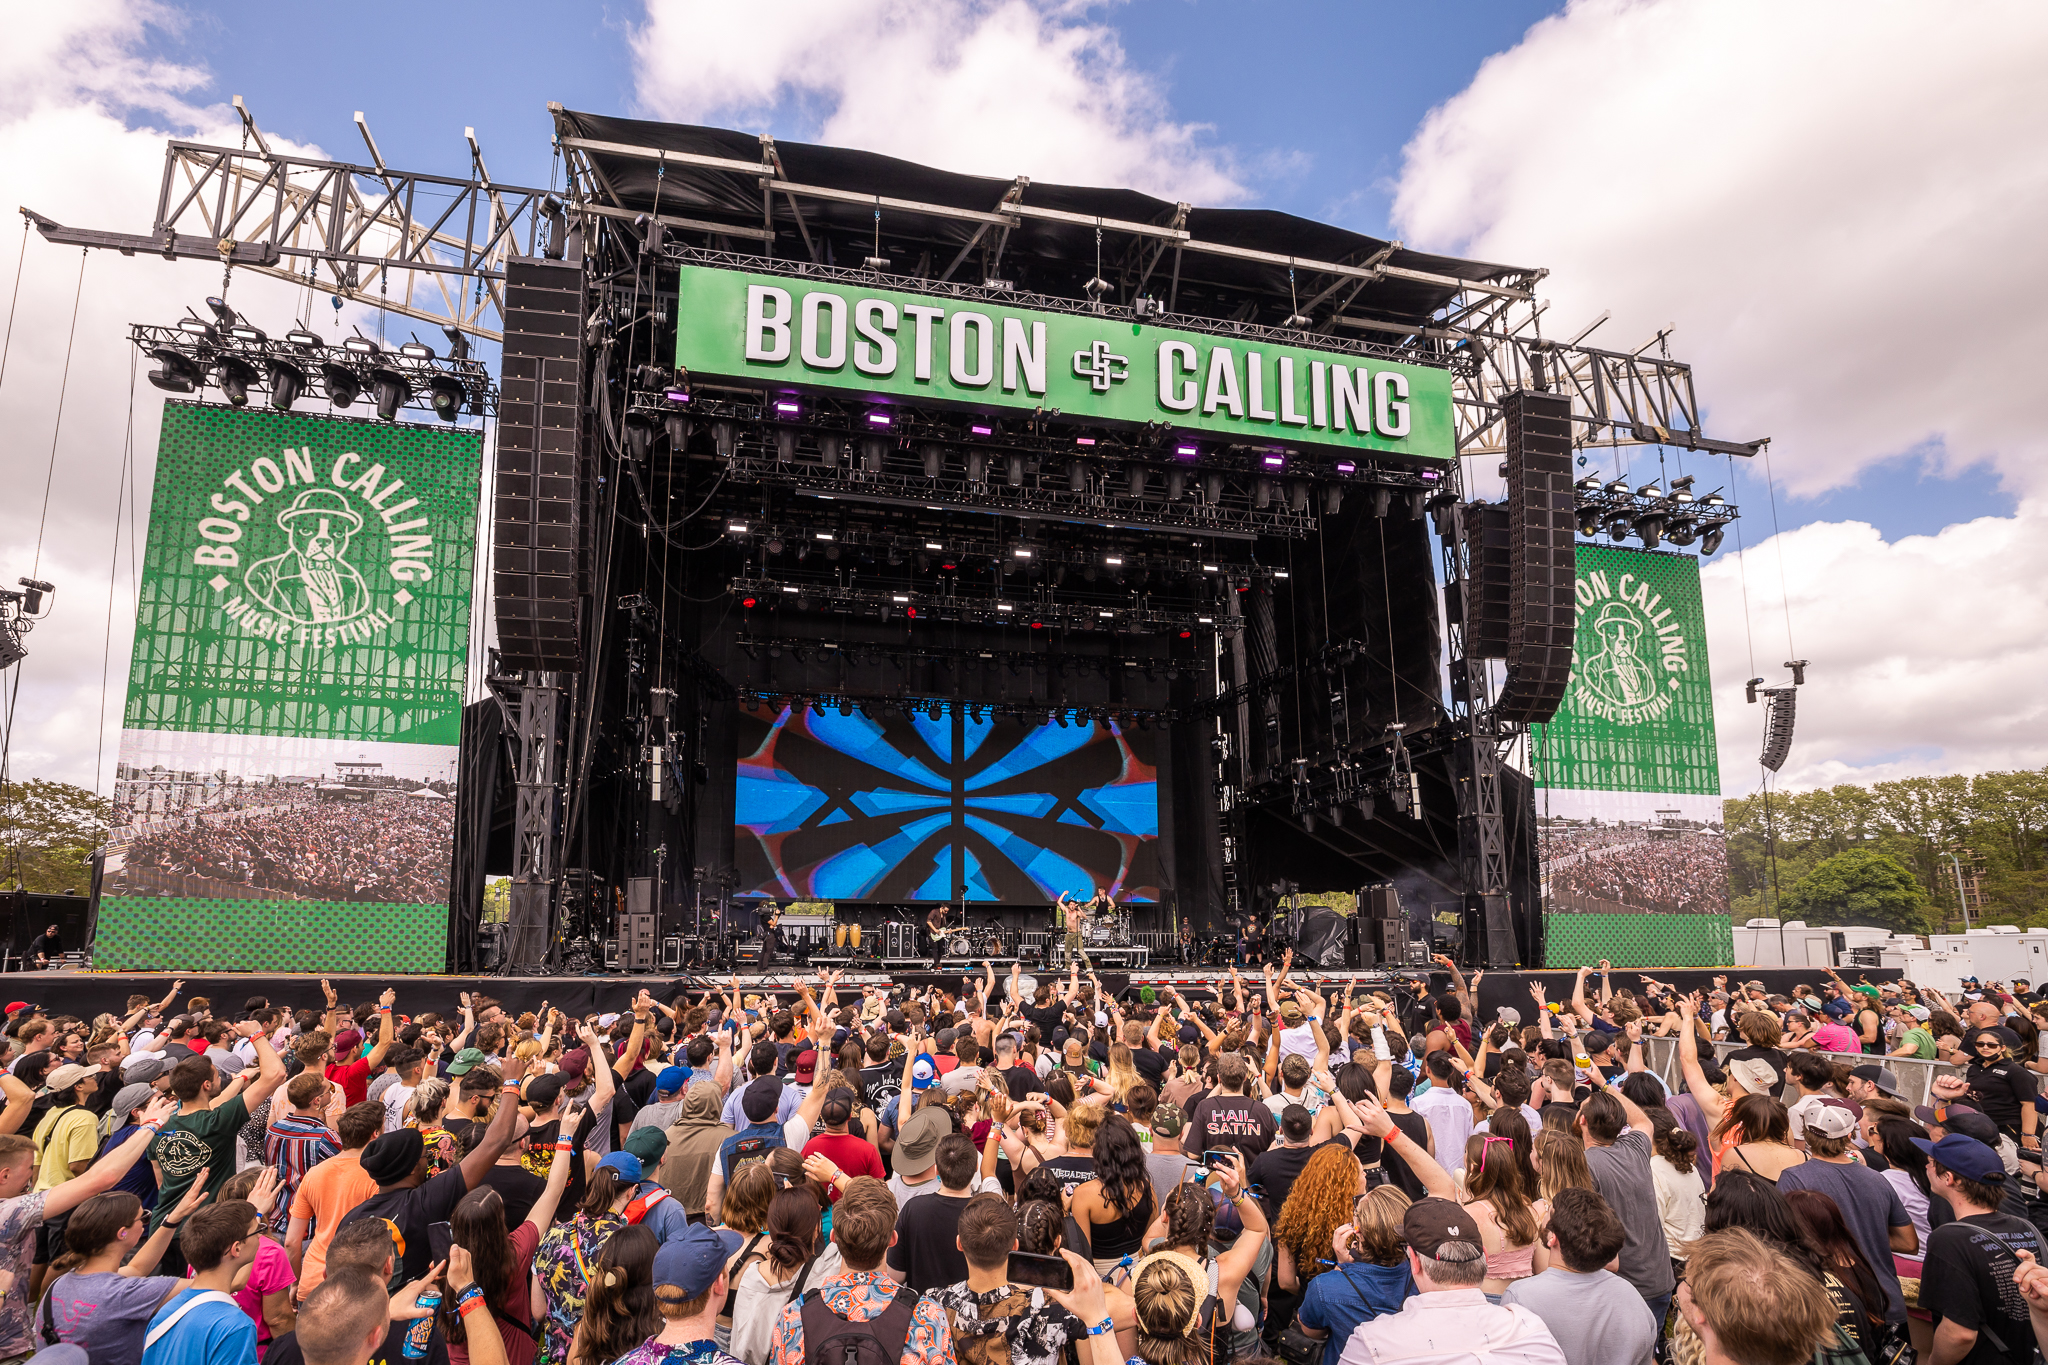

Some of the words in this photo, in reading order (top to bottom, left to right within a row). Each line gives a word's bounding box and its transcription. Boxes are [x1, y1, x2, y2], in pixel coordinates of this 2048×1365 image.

[744, 284, 1049, 394] BOSTON
[1158, 340, 1412, 437] CALLING
[193, 446, 316, 568] BOSTON
[331, 452, 434, 583] CALLING
[221, 595, 291, 645] MUSIC
[299, 607, 396, 650] FESTIVAL
[1619, 573, 1689, 672] CALLING
[1573, 685, 1617, 723] MUSIC
[1620, 691, 1674, 725] FESTIVAL
[1206, 1122, 1262, 1136] SATIN
[1211, 1109, 1256, 1123] HAIL
[411, 1328, 432, 1343] HAZY
